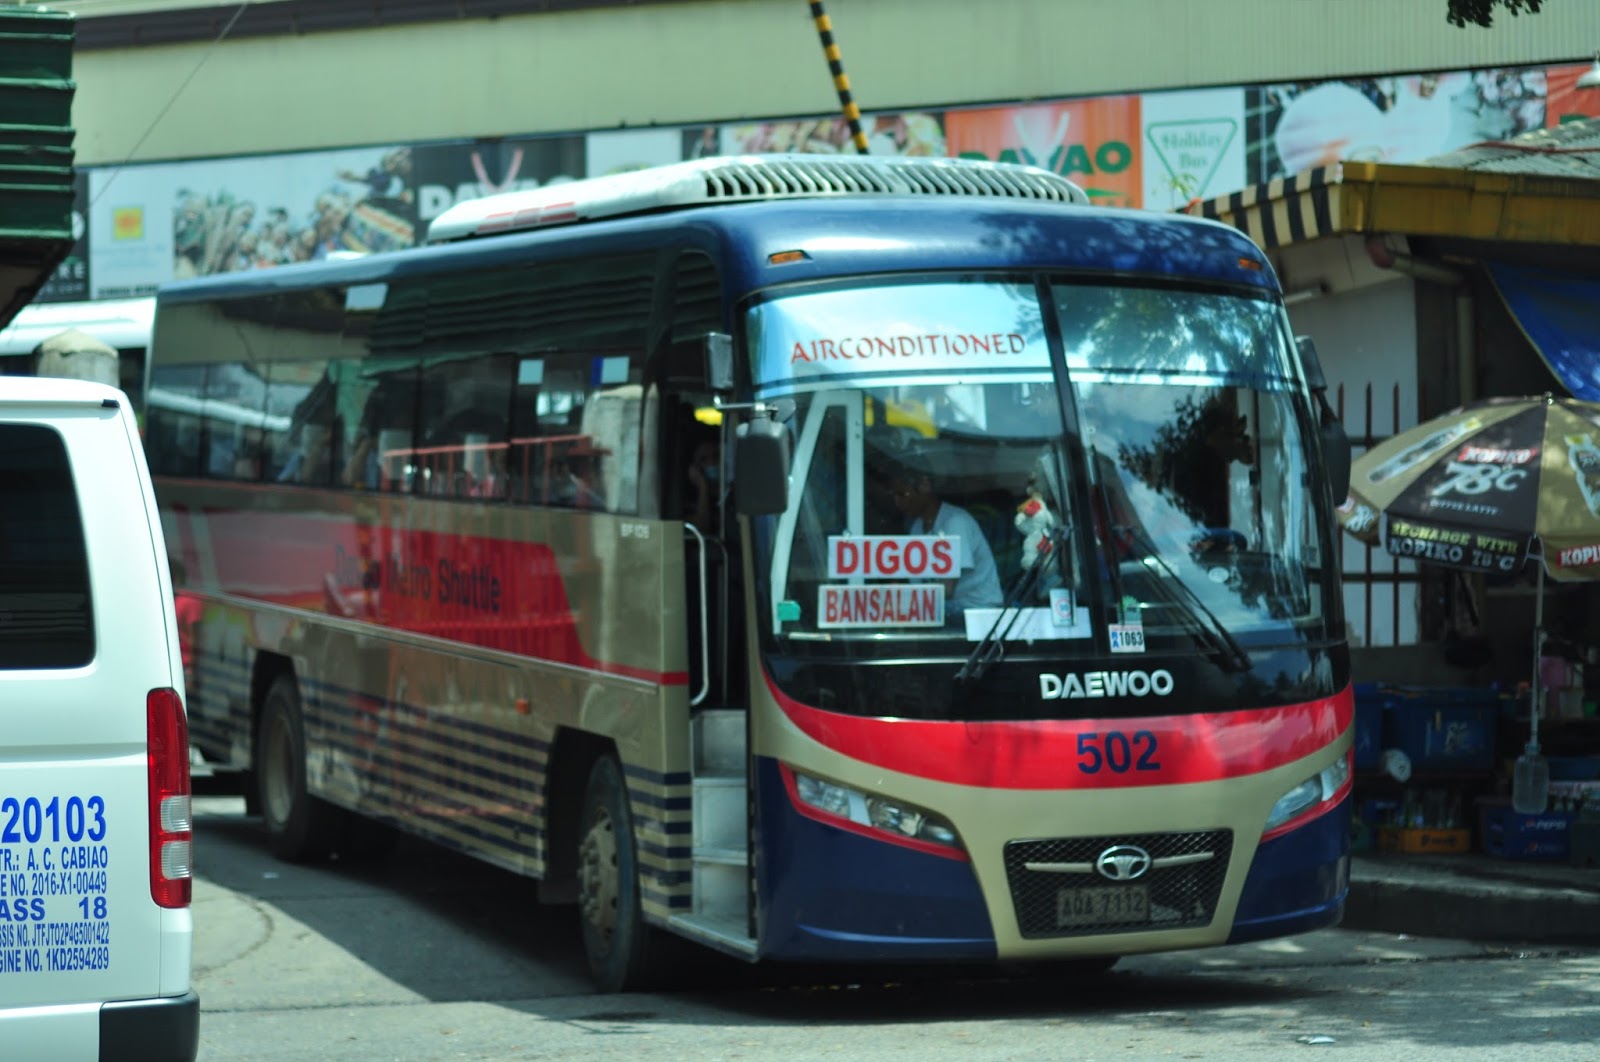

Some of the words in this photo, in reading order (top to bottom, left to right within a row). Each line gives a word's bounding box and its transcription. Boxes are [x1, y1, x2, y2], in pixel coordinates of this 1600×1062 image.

[791, 333, 1026, 364] AIRCONDITIONED
[1464, 447, 1531, 464] KOPIKO
[1390, 538, 1464, 562] KOPIKO
[1391, 521, 1470, 546] RECHARGE
[1477, 535, 1519, 553] WITH
[836, 540, 953, 575] DIGOS
[438, 559, 501, 612] Shuttle
[826, 589, 936, 623] BANSALAN
[1119, 631, 1144, 647] 1063
[1040, 669, 1174, 699] DAEWOO
[1076, 730, 1161, 774] 502
[1, 796, 107, 843] 20103
[27, 848, 39, 870] A.
[43, 847, 55, 870] C.
[61, 845, 108, 869] CABIAO
[11, 873, 28, 896] NO.
[32, 871, 107, 895] 2016-X1-00449
[79, 896, 107, 919] 18
[0, 924, 14, 947] SIS
[17, 924, 30, 947] NO.
[25, 948, 42, 972] NO.
[46, 947, 109, 971] 1KD2594289
